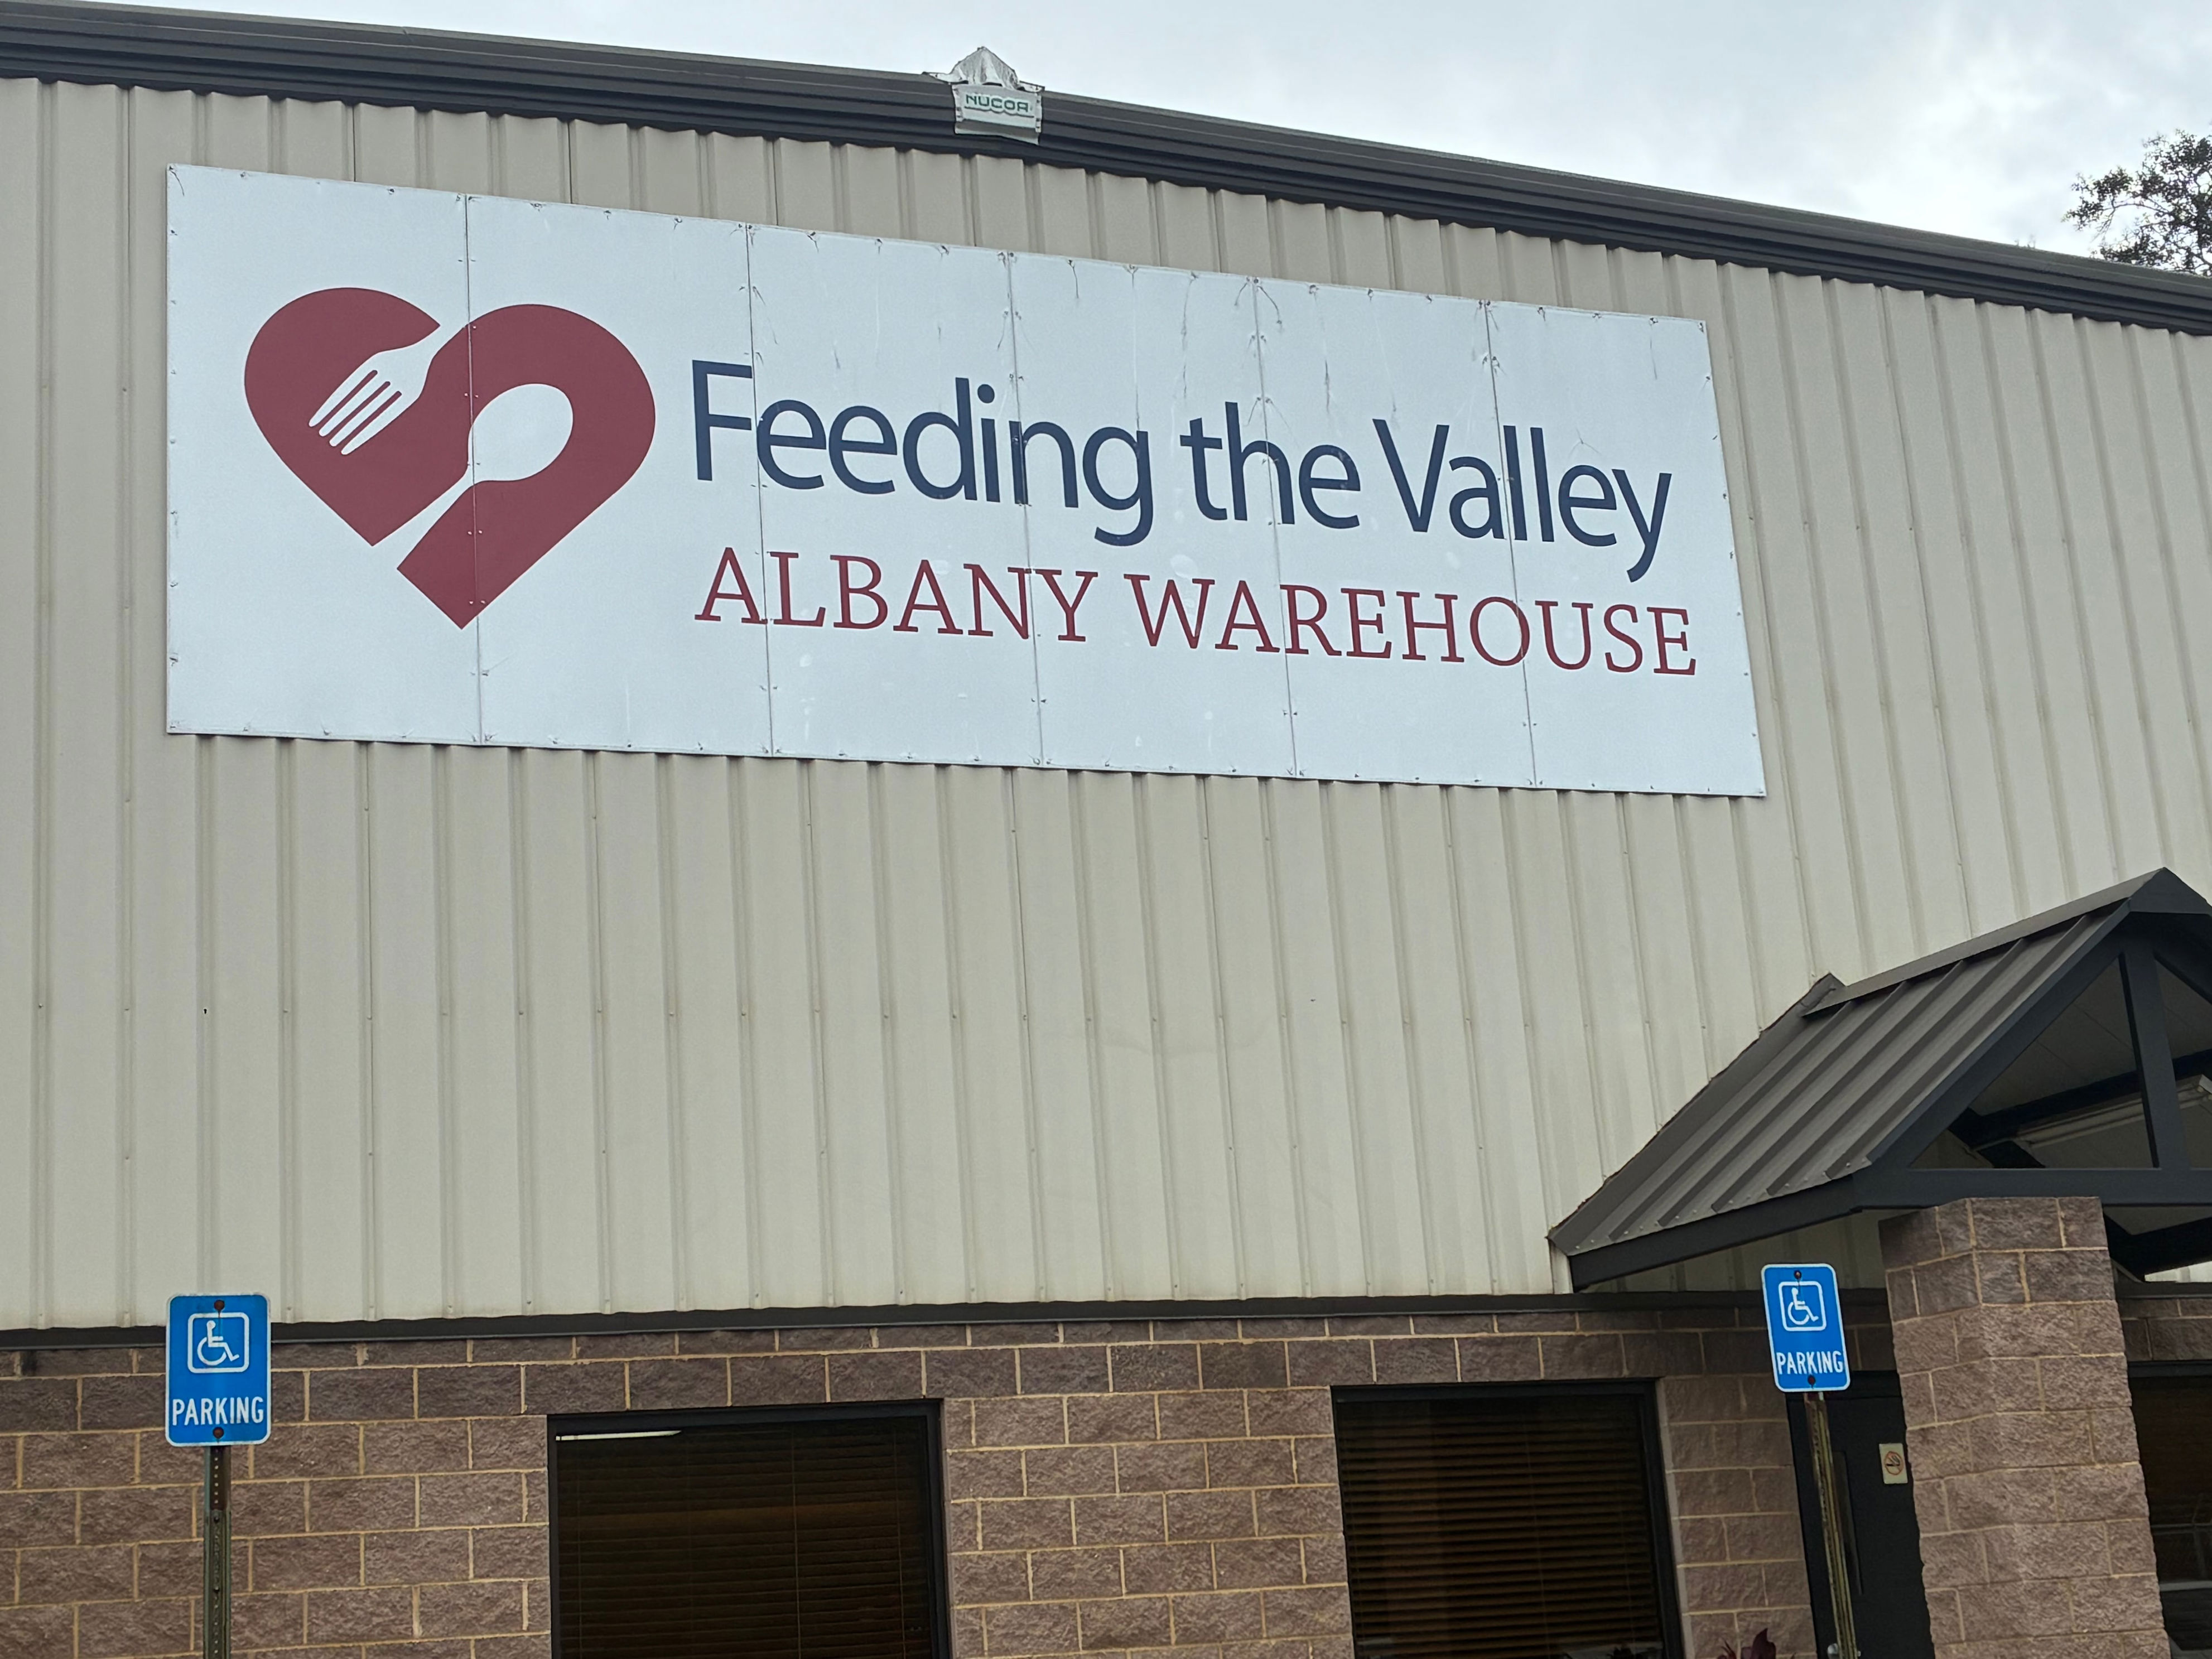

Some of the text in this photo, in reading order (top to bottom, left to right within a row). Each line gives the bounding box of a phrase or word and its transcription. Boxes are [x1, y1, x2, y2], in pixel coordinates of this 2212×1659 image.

[965, 94, 1029, 113] NUCOR
[692, 360, 1673, 583] Feeding the Valley
[694, 547, 1697, 676] ALBANY WAREHOUSE
[1775, 1350, 1844, 1375] PARKING
[172, 1396, 264, 1426] PARKING
